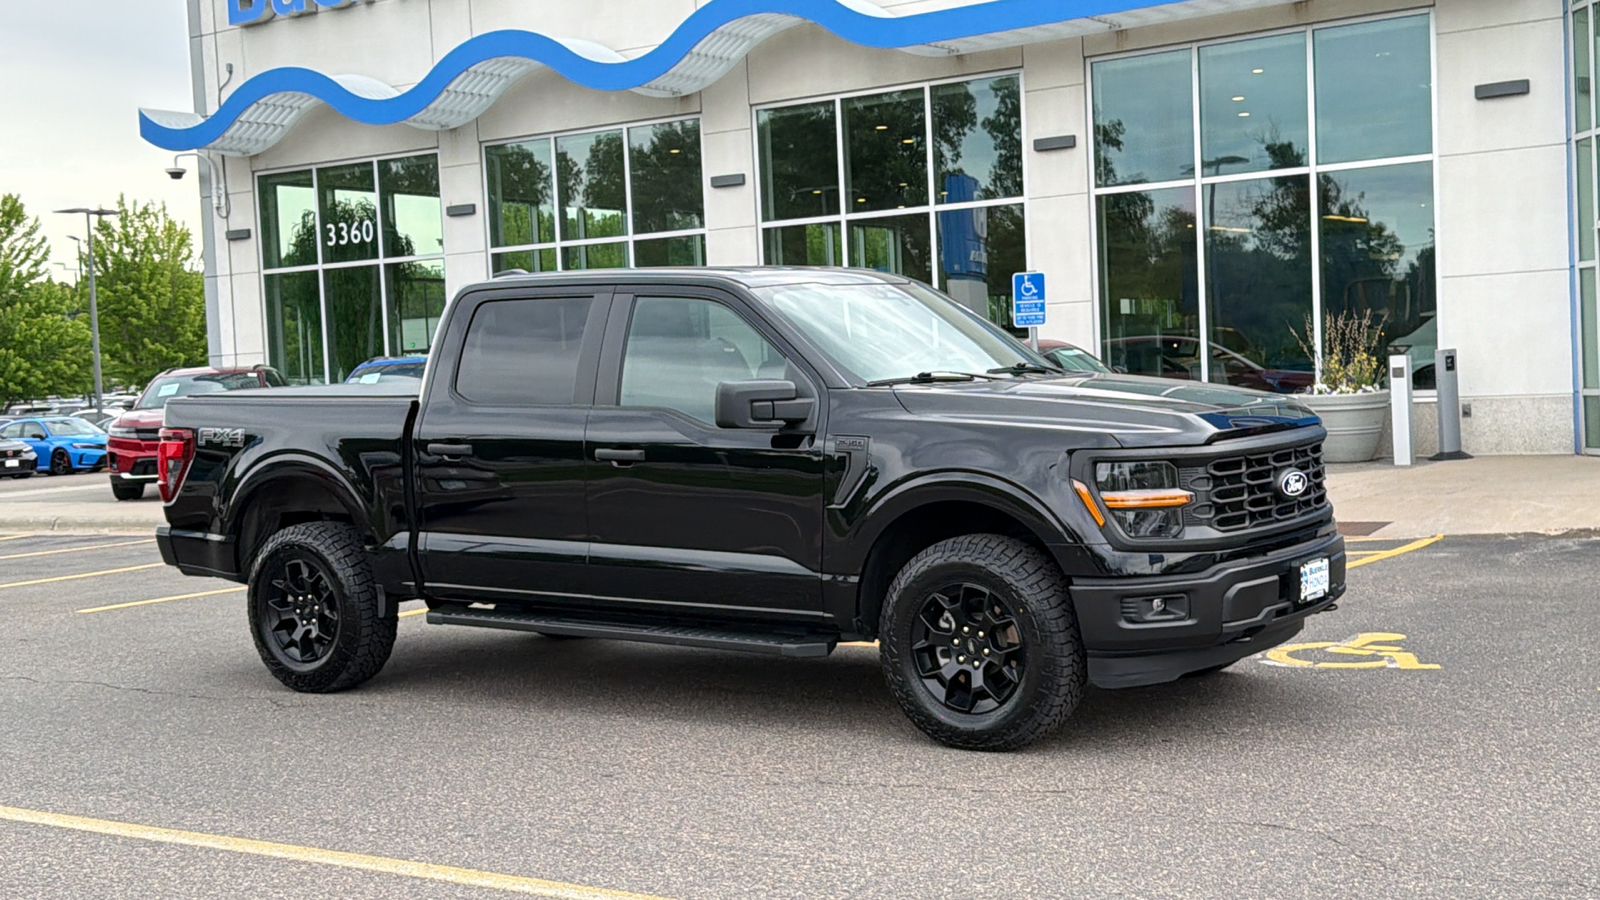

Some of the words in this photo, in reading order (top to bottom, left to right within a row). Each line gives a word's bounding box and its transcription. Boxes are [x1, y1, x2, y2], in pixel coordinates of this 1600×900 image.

[326, 220, 373, 247] 3360
[198, 428, 245, 446] FX4
[1287, 475, 1303, 492] Ford
